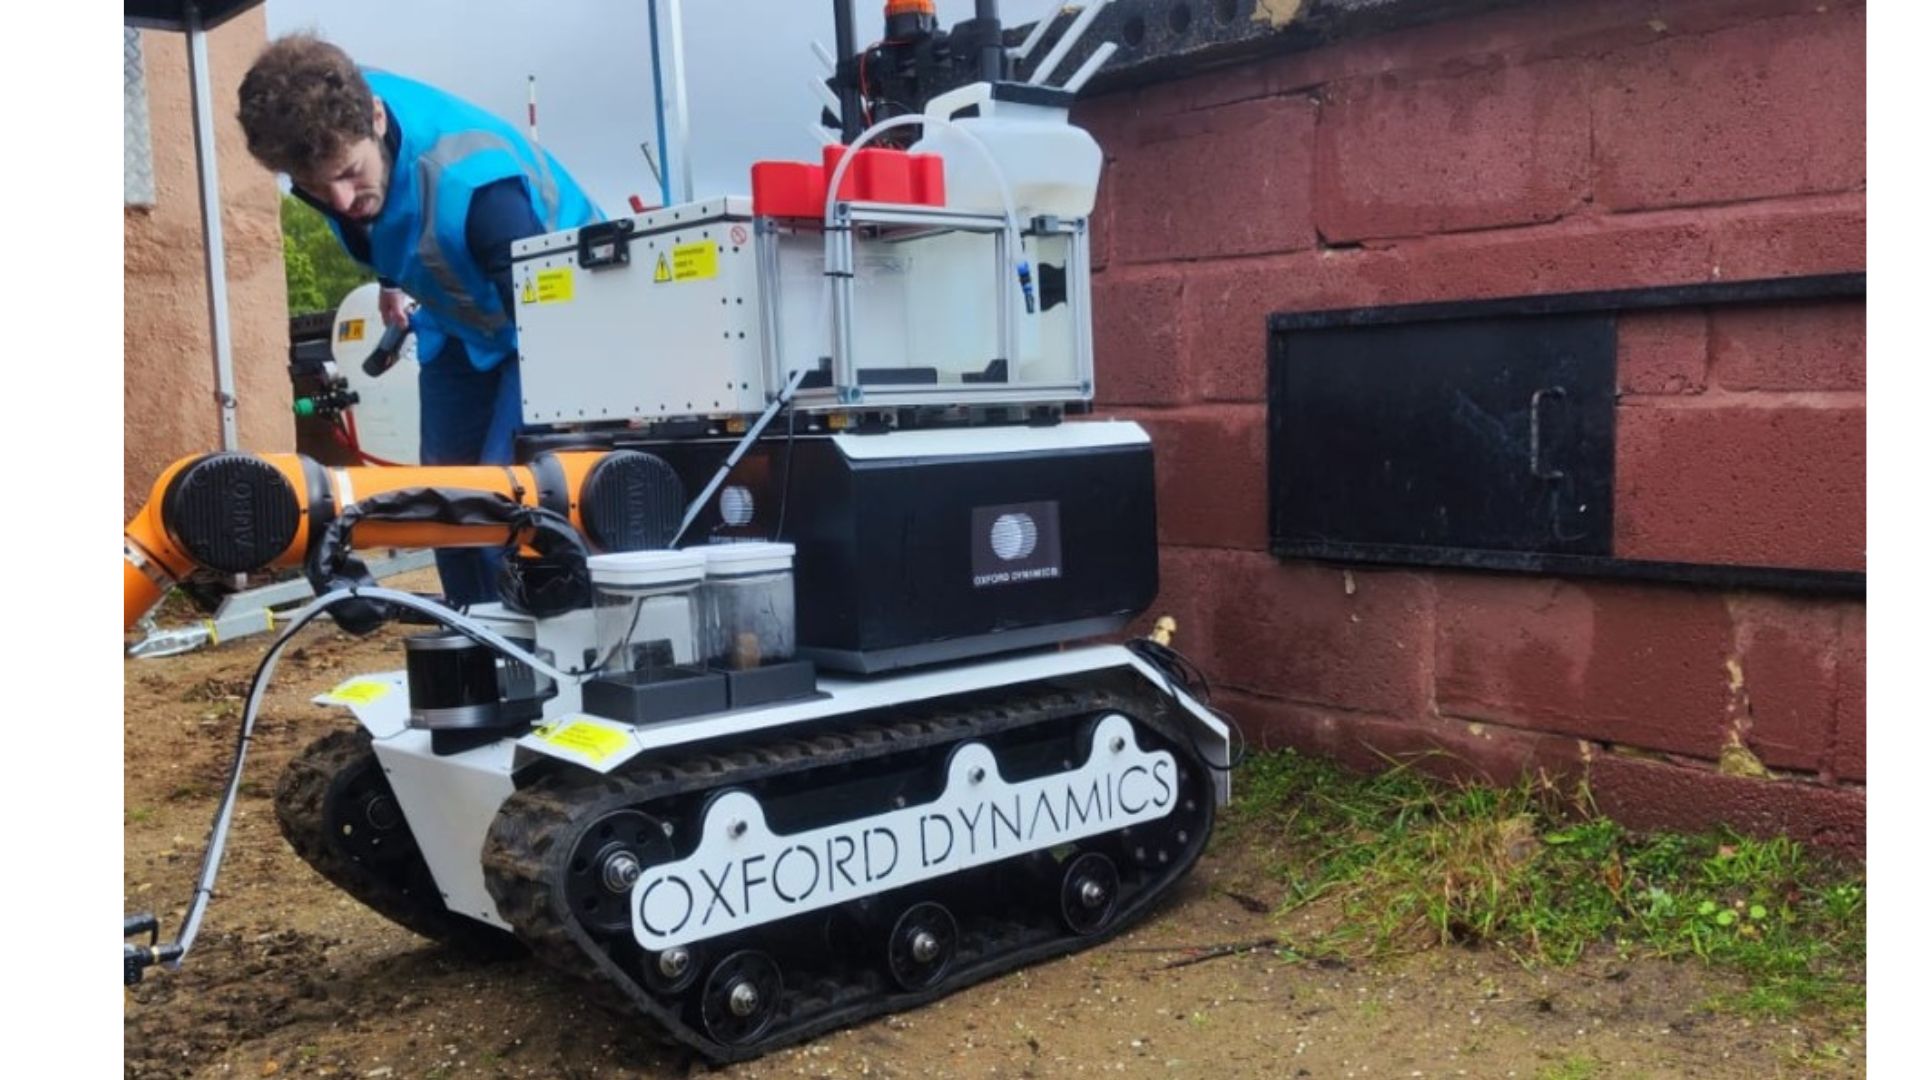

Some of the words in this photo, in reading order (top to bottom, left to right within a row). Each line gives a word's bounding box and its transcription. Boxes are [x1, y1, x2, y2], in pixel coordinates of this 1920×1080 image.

[974, 572, 1010, 586] OXFORD
[639, 826, 899, 937] OXFORD
[920, 759, 1171, 868] DYNAMICS
